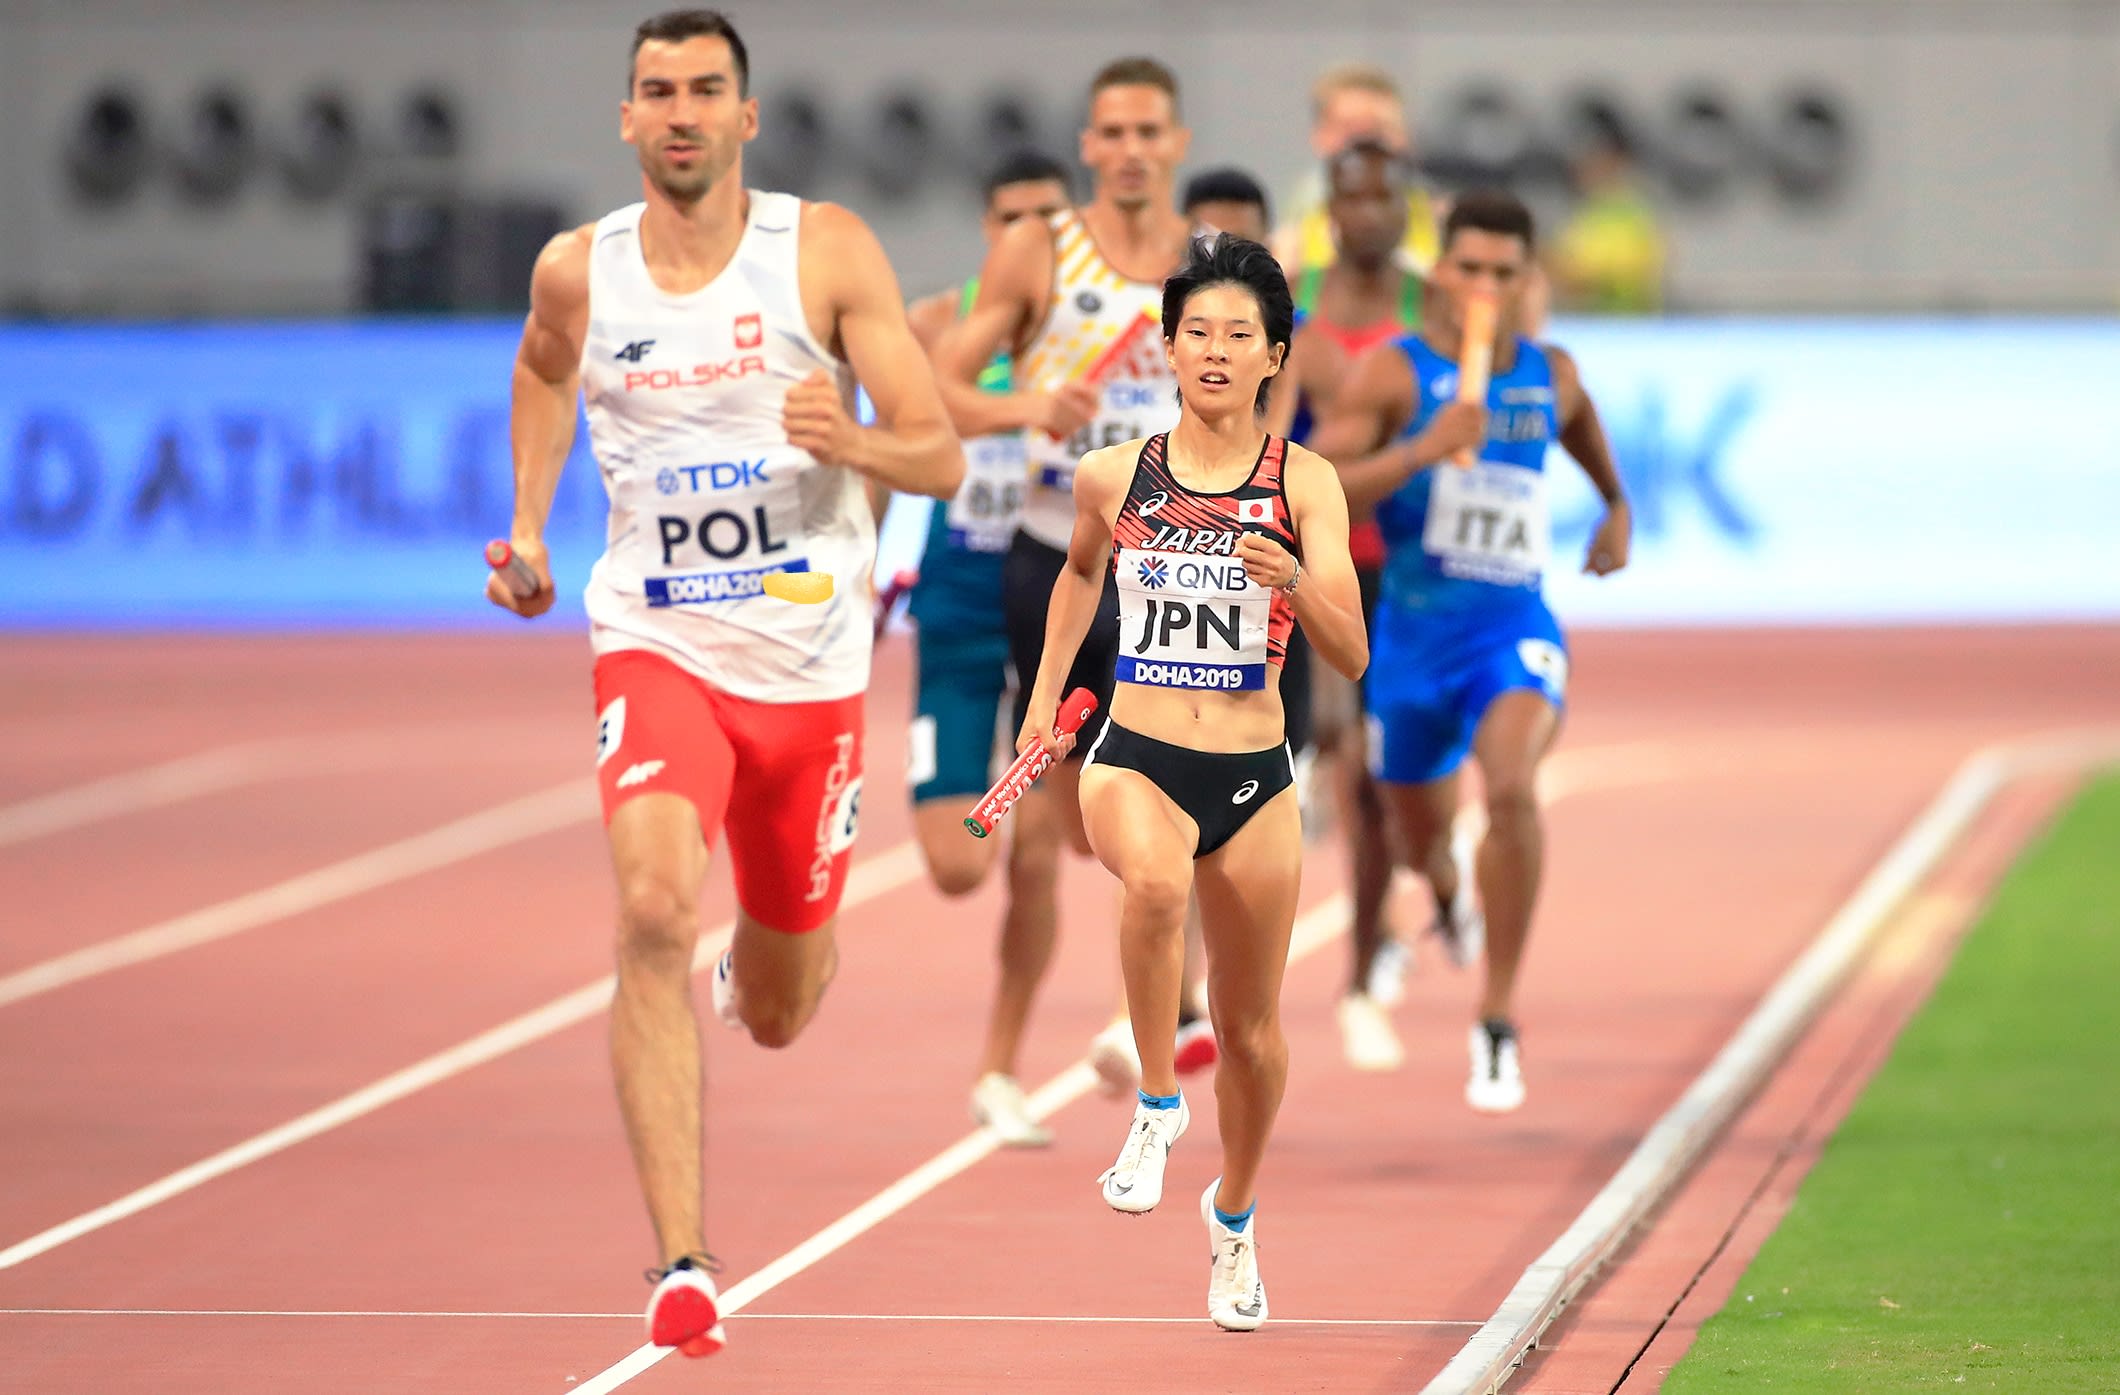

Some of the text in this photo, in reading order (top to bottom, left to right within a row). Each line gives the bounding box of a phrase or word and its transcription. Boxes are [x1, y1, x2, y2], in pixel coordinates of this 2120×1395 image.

[624, 355, 767, 393] POLSKA
[679, 458, 771, 493] TDK
[657, 505, 787, 566] POL
[1141, 525, 1263, 555] JAPA
[1455, 507, 1529, 551] ITA
[665, 567, 787, 602] DOHA20
[1176, 562, 1248, 591] QNB
[1134, 599, 1241, 655] JPN
[1134, 661, 1243, 689] DOHA2019
[996, 783, 1011, 802] World
[1009, 763, 1030, 787] Athletics
